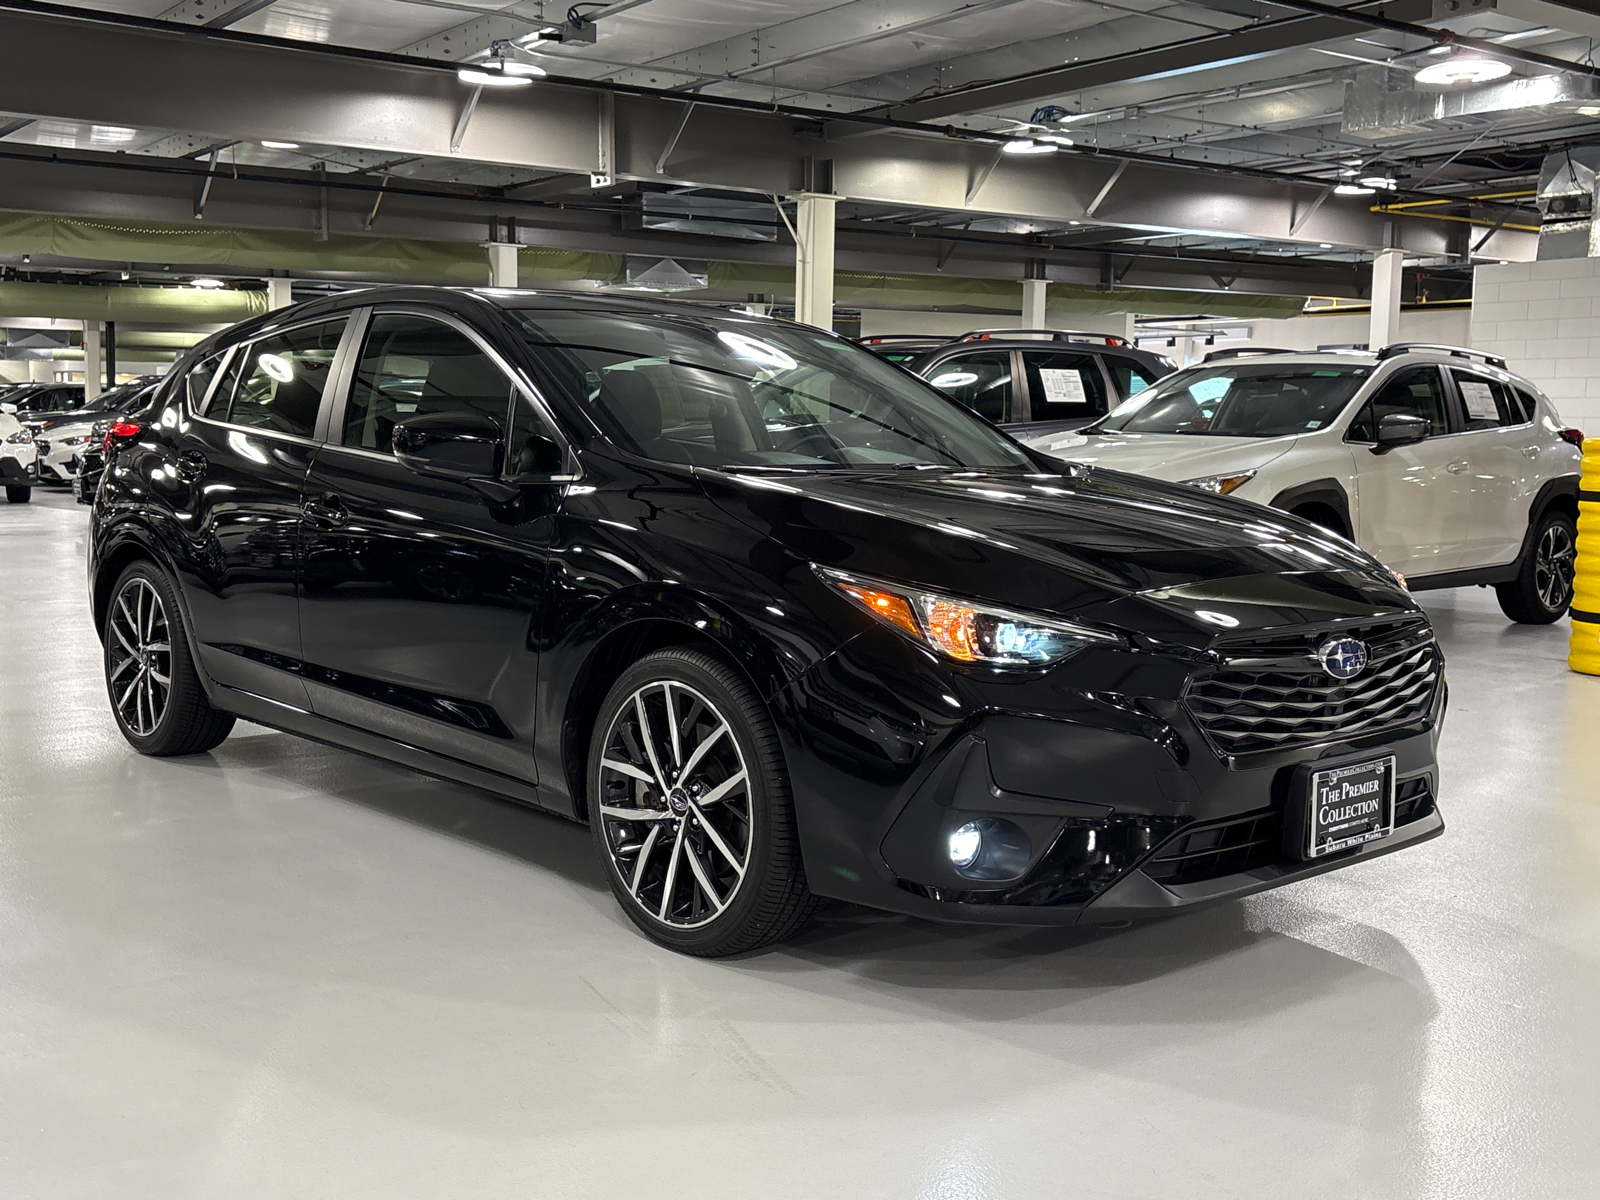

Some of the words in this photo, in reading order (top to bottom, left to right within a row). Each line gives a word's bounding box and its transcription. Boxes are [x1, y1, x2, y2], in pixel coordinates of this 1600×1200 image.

[1320, 786, 1340, 805] THE
[1341, 780, 1379, 800] PREMIER
[1319, 798, 1379, 825] COLLECTION
[1325, 841, 1346, 853] Subaru
[1347, 835, 1364, 846] White
[1365, 831, 1382, 842] Plains
